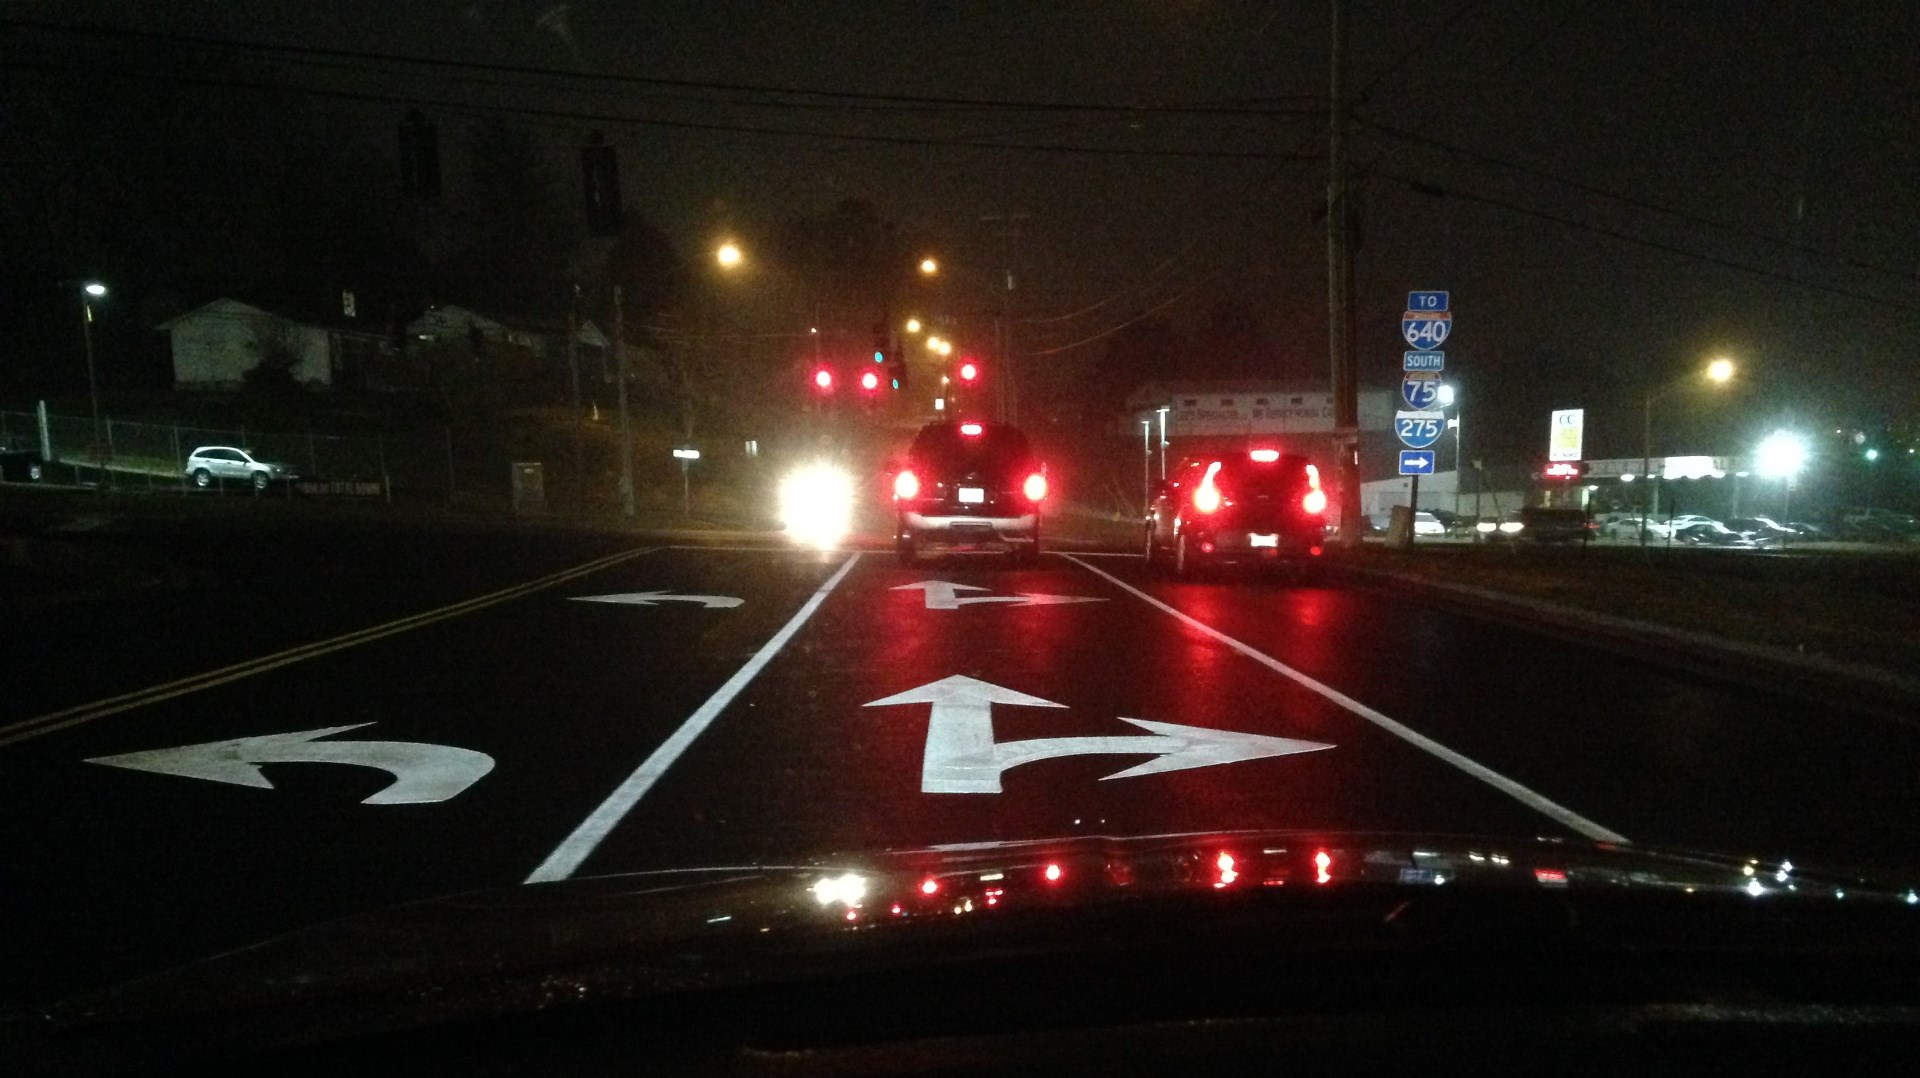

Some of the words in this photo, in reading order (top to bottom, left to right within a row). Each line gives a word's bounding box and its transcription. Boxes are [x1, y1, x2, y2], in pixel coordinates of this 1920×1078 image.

[1419, 296, 1437, 307] TO
[1407, 321, 1446, 342] 640
[1407, 355, 1441, 367] SOUTH
[1407, 381, 1437, 402] 75
[1400, 420, 1438, 437] 275
